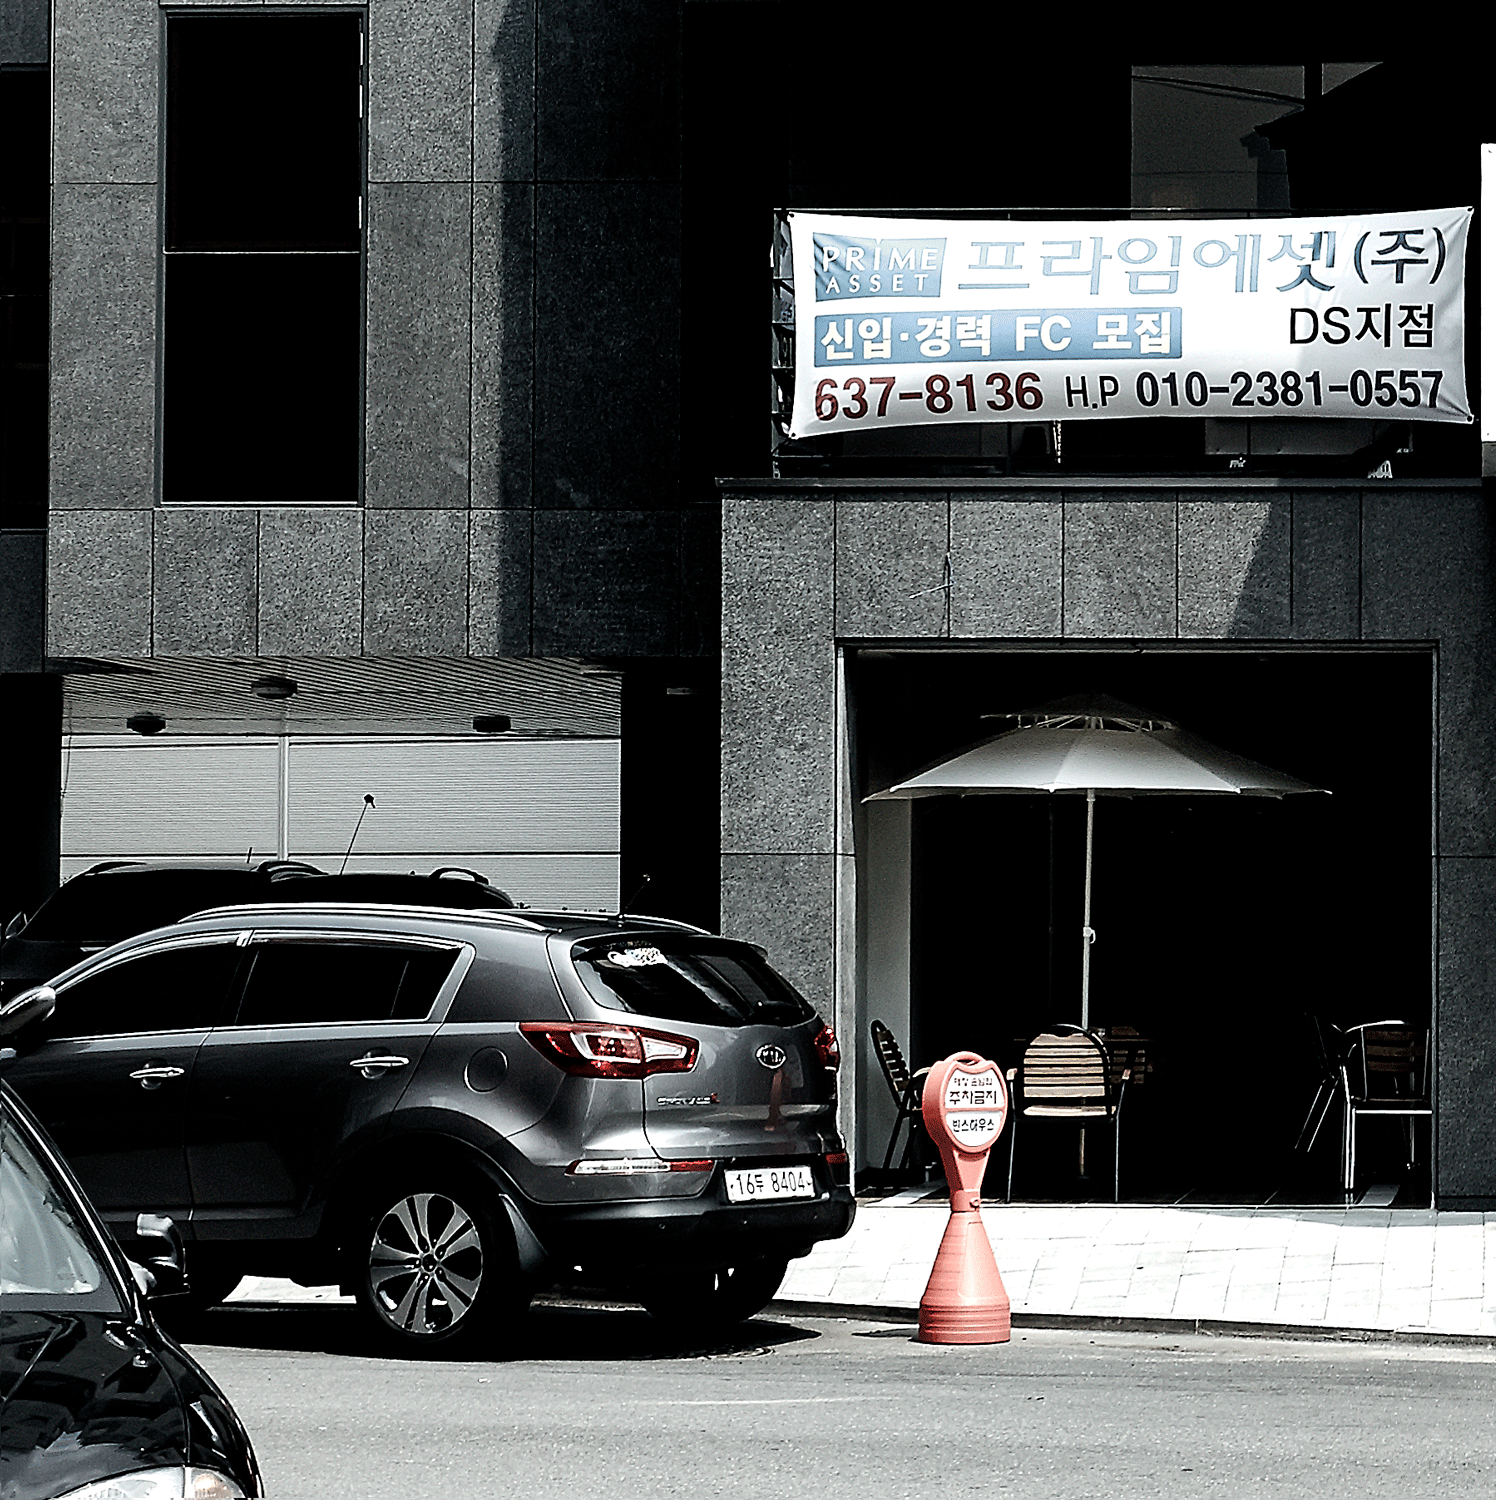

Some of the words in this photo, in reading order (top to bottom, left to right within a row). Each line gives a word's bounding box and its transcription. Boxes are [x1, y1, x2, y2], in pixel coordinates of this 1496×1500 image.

[821, 244, 939, 273] PRIME
[825, 273, 930, 295] ASSET
[1015, 314, 1073, 353] FC
[1092, 310, 1172, 356] 모집
[1289, 301, 1435, 349] DS지점
[813, 371, 1045, 422] 637-8136
[1065, 374, 1120, 410] H.P
[1135, 368, 1444, 409] 010-2381-0557
[949, 1090, 997, 1105] 주차금지
[770, 1171, 806, 1193] 8404
